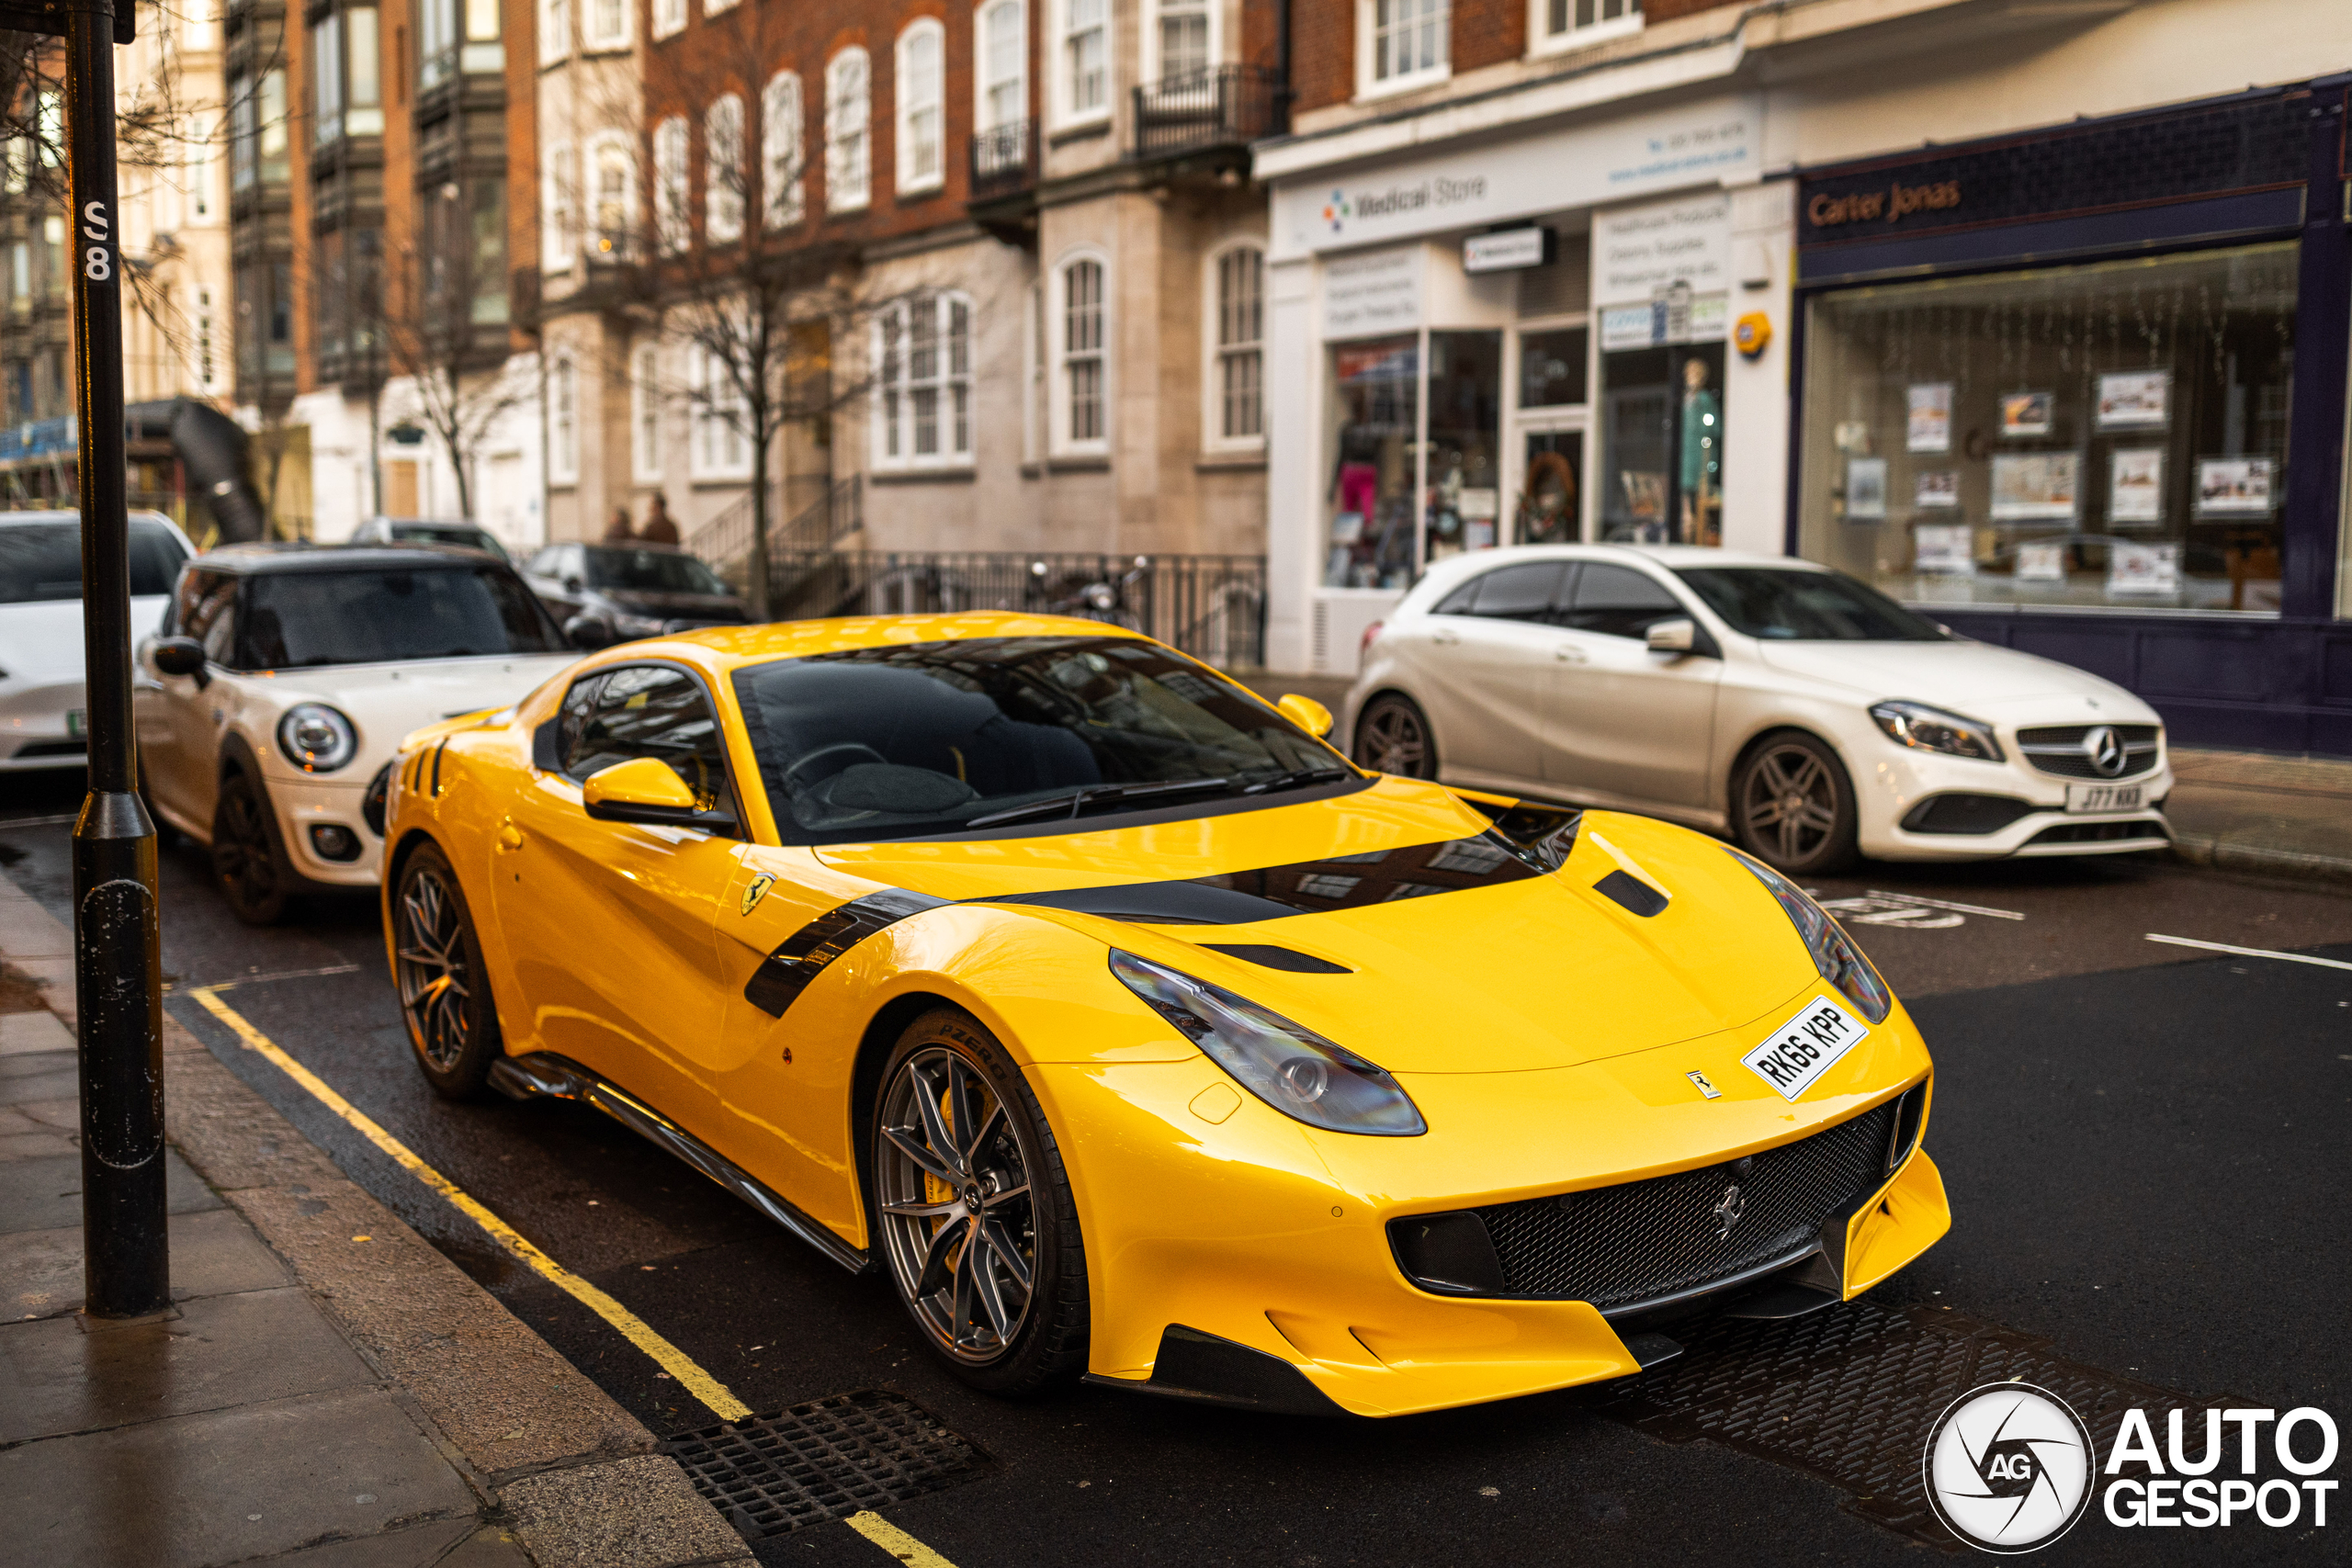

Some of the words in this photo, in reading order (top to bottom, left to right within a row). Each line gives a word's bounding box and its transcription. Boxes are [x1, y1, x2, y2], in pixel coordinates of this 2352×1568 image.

[1356, 182, 1430, 220] Medical
[1435, 175, 1487, 207] Store
[1808, 192, 1884, 228] Carter
[1886, 179, 1962, 224] Jonas
[1757, 1034, 1821, 1088] RK66
[1801, 1007, 1849, 1048] KPP
